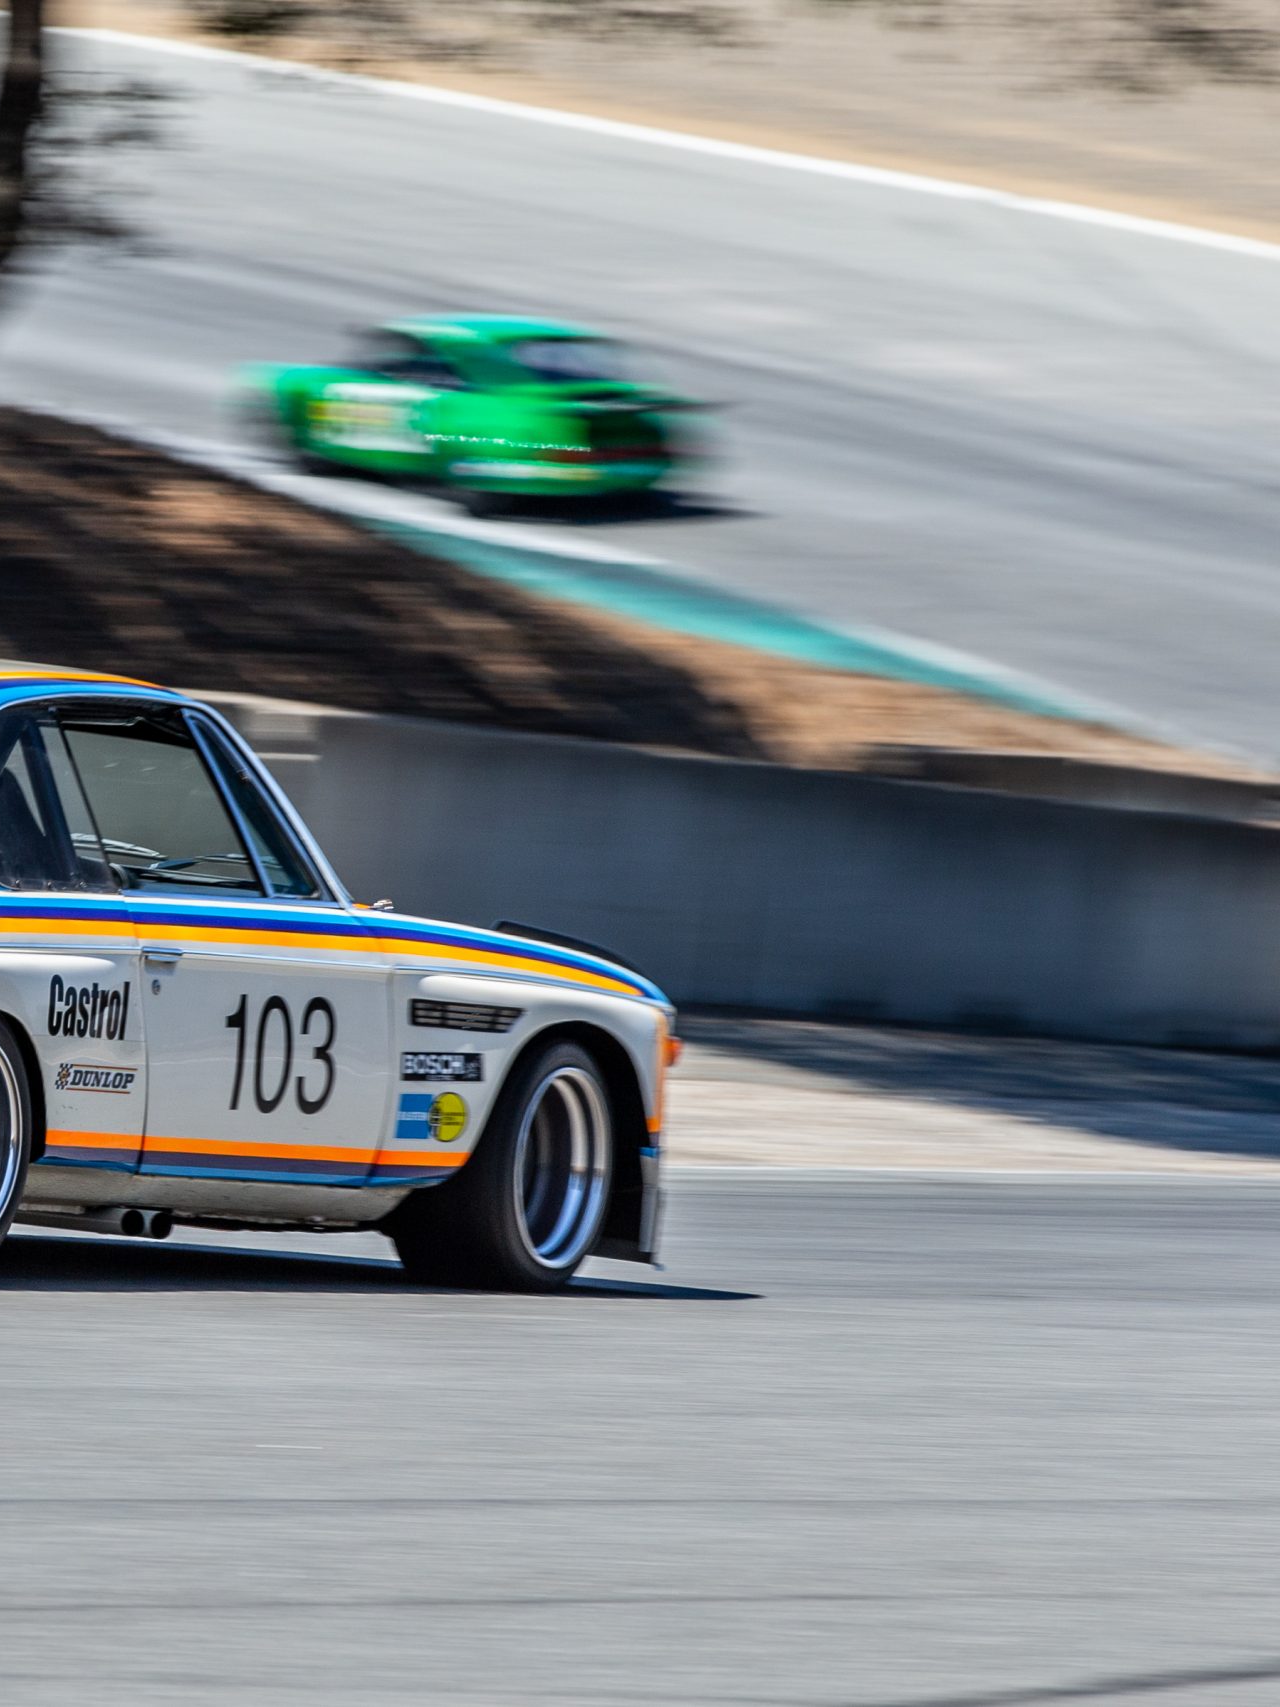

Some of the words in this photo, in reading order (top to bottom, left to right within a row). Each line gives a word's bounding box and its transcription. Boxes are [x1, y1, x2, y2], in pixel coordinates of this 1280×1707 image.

[48, 974, 130, 1041] Castrol
[225, 993, 337, 1115] 103
[401, 1054, 465, 1075] BOSCH
[70, 1069, 135, 1090] DUNLOP
